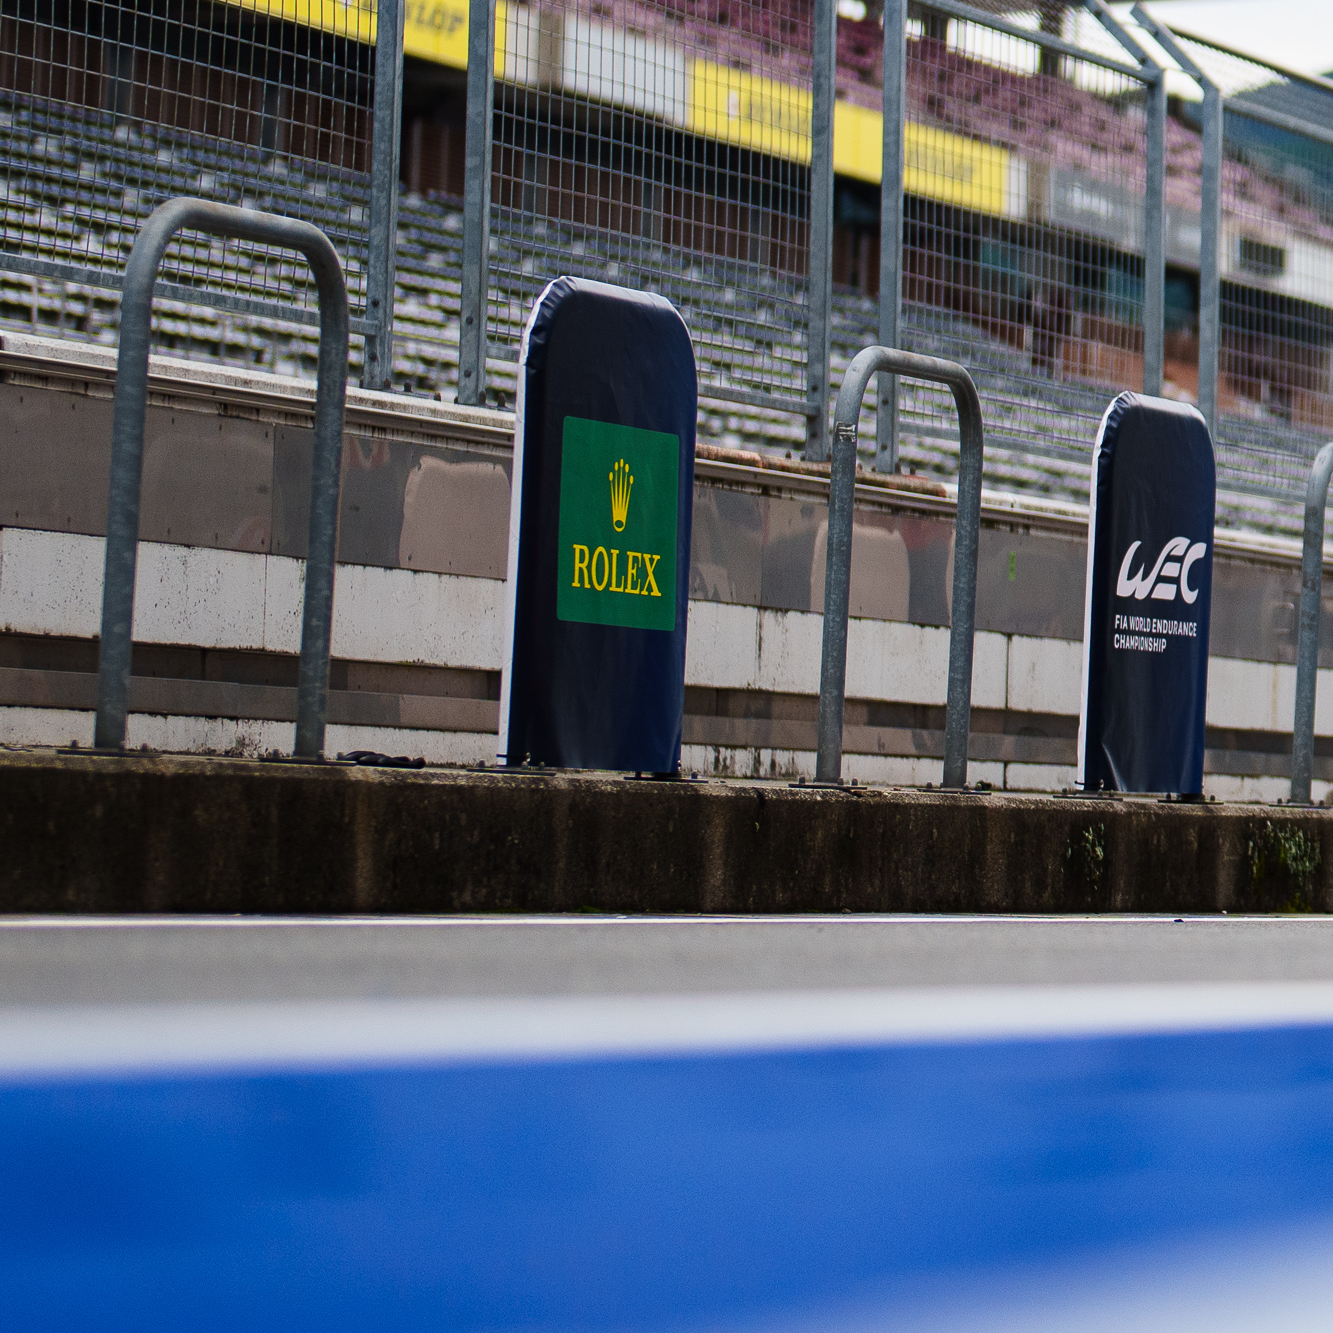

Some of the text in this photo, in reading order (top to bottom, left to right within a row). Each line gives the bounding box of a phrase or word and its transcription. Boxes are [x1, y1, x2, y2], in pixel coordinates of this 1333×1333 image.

[571, 544, 662, 597] ROLEX
[1116, 536, 1207, 604] WEC
[1114, 634, 1166, 653] CHAMPIONSHIP
[1115, 615, 1197, 637] FIA WORLD ENDURANCE
